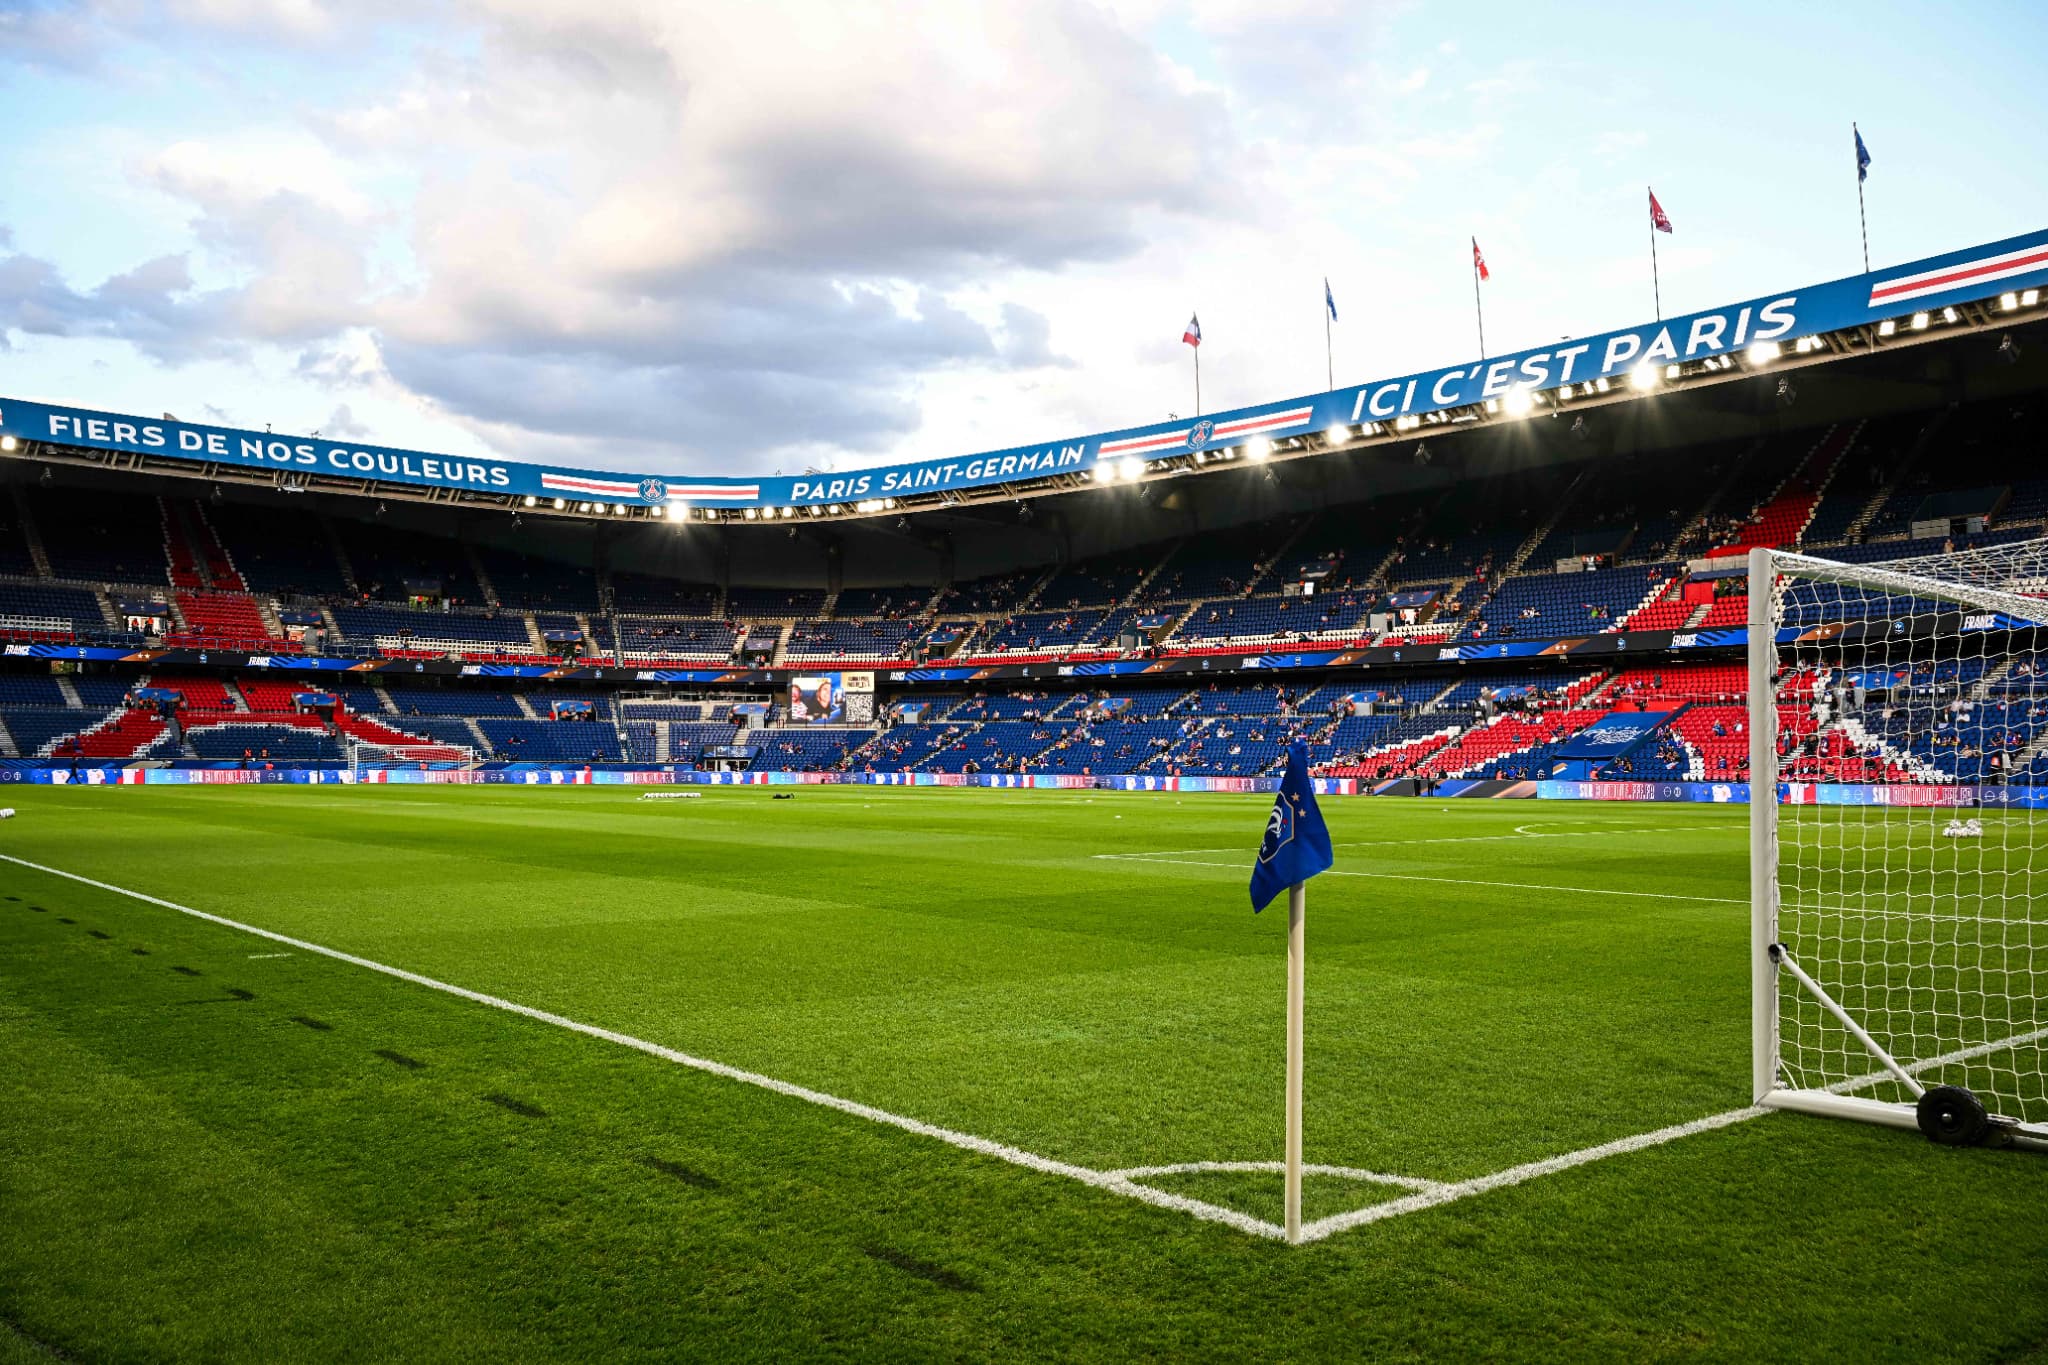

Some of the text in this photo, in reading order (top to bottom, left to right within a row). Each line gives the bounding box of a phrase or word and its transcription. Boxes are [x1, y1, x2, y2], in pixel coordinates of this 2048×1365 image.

[1351, 297, 1799, 422] ICI C'EST PARIS
[49, 414, 510, 486] FIERS DE NOS COULEURS
[791, 445, 1085, 501] PARIS SAINT-GERMAIN
